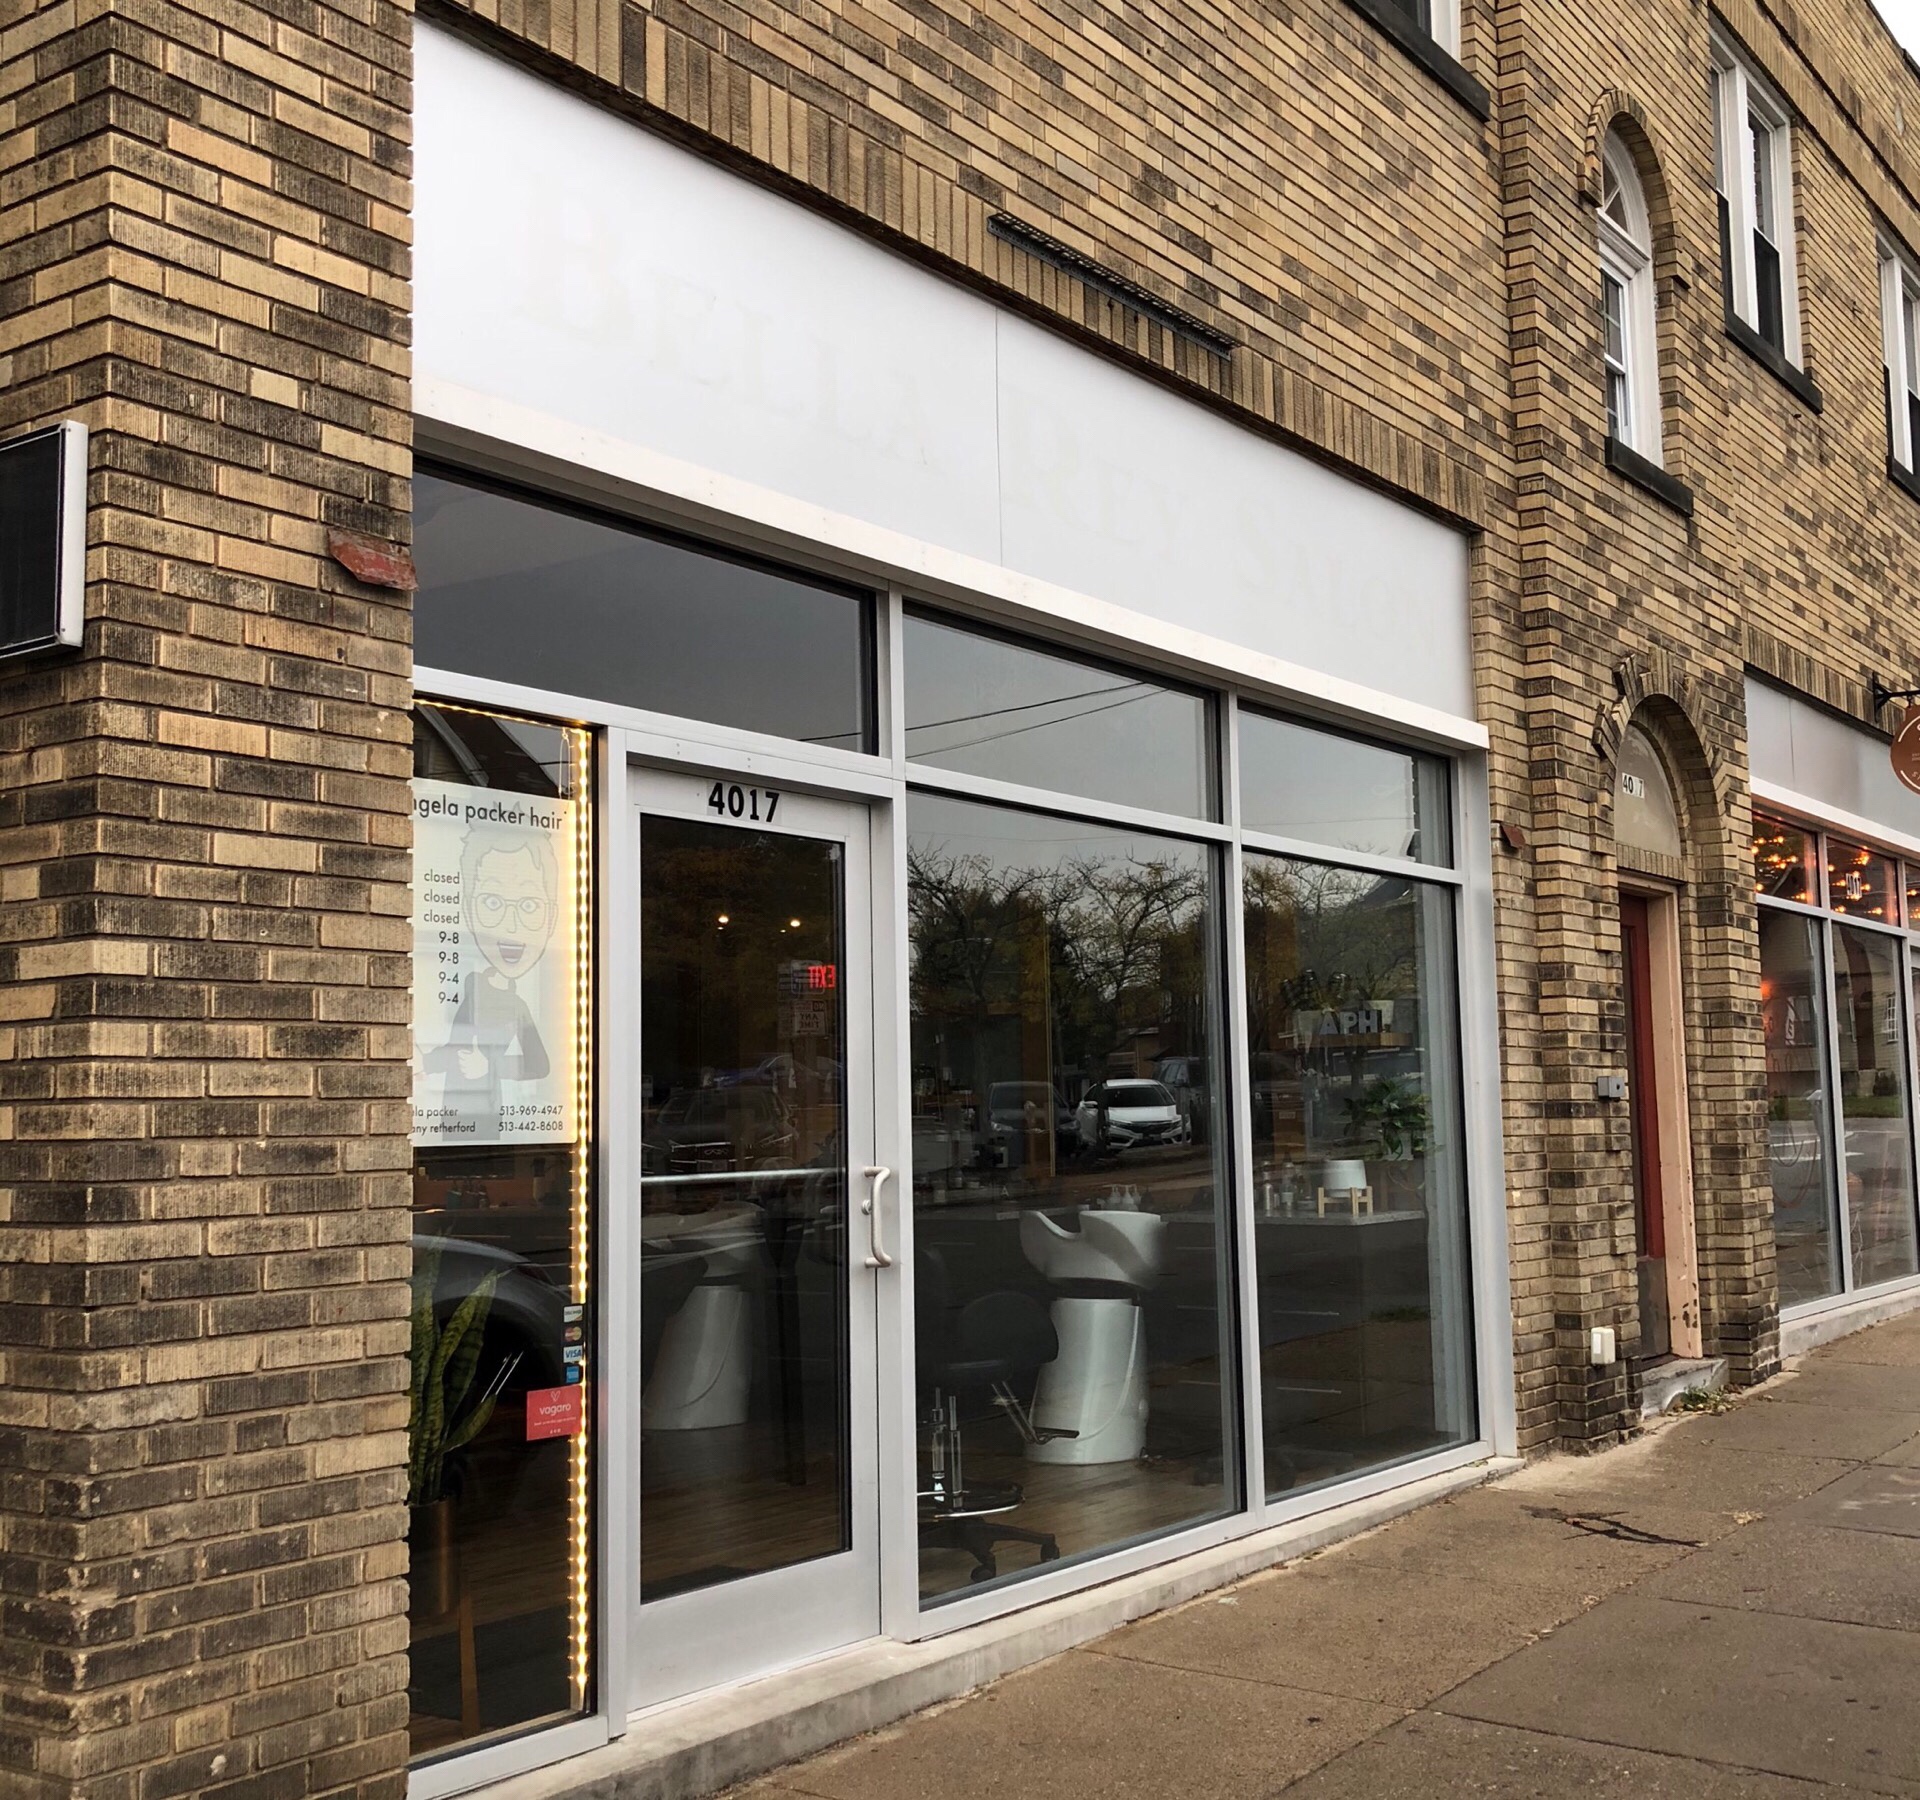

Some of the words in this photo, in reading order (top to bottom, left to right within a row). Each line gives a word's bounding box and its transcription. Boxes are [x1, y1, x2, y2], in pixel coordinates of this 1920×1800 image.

[1623, 775, 1643, 797] 407
[708, 782, 780, 823] 4017
[465, 802, 525, 825] packer
[530, 807, 563, 830] hair
[424, 869, 460, 884] closed
[424, 889, 460, 904] closed
[424, 909, 460, 924] closed
[438, 931, 459, 944] 9-8
[438, 951, 459, 964] 9-8
[438, 971, 459, 984] 9-4
[438, 991, 459, 1004] 9-4
[426, 1106, 459, 1119] packer
[499, 1105, 564, 1116] 513-969-4947
[430, 1121, 476, 1133] retherford
[498, 1121, 564, 1132] 513-442-8608
[565, 1349, 582, 1358] VISA
[539, 1403, 571, 1417] vagaro
